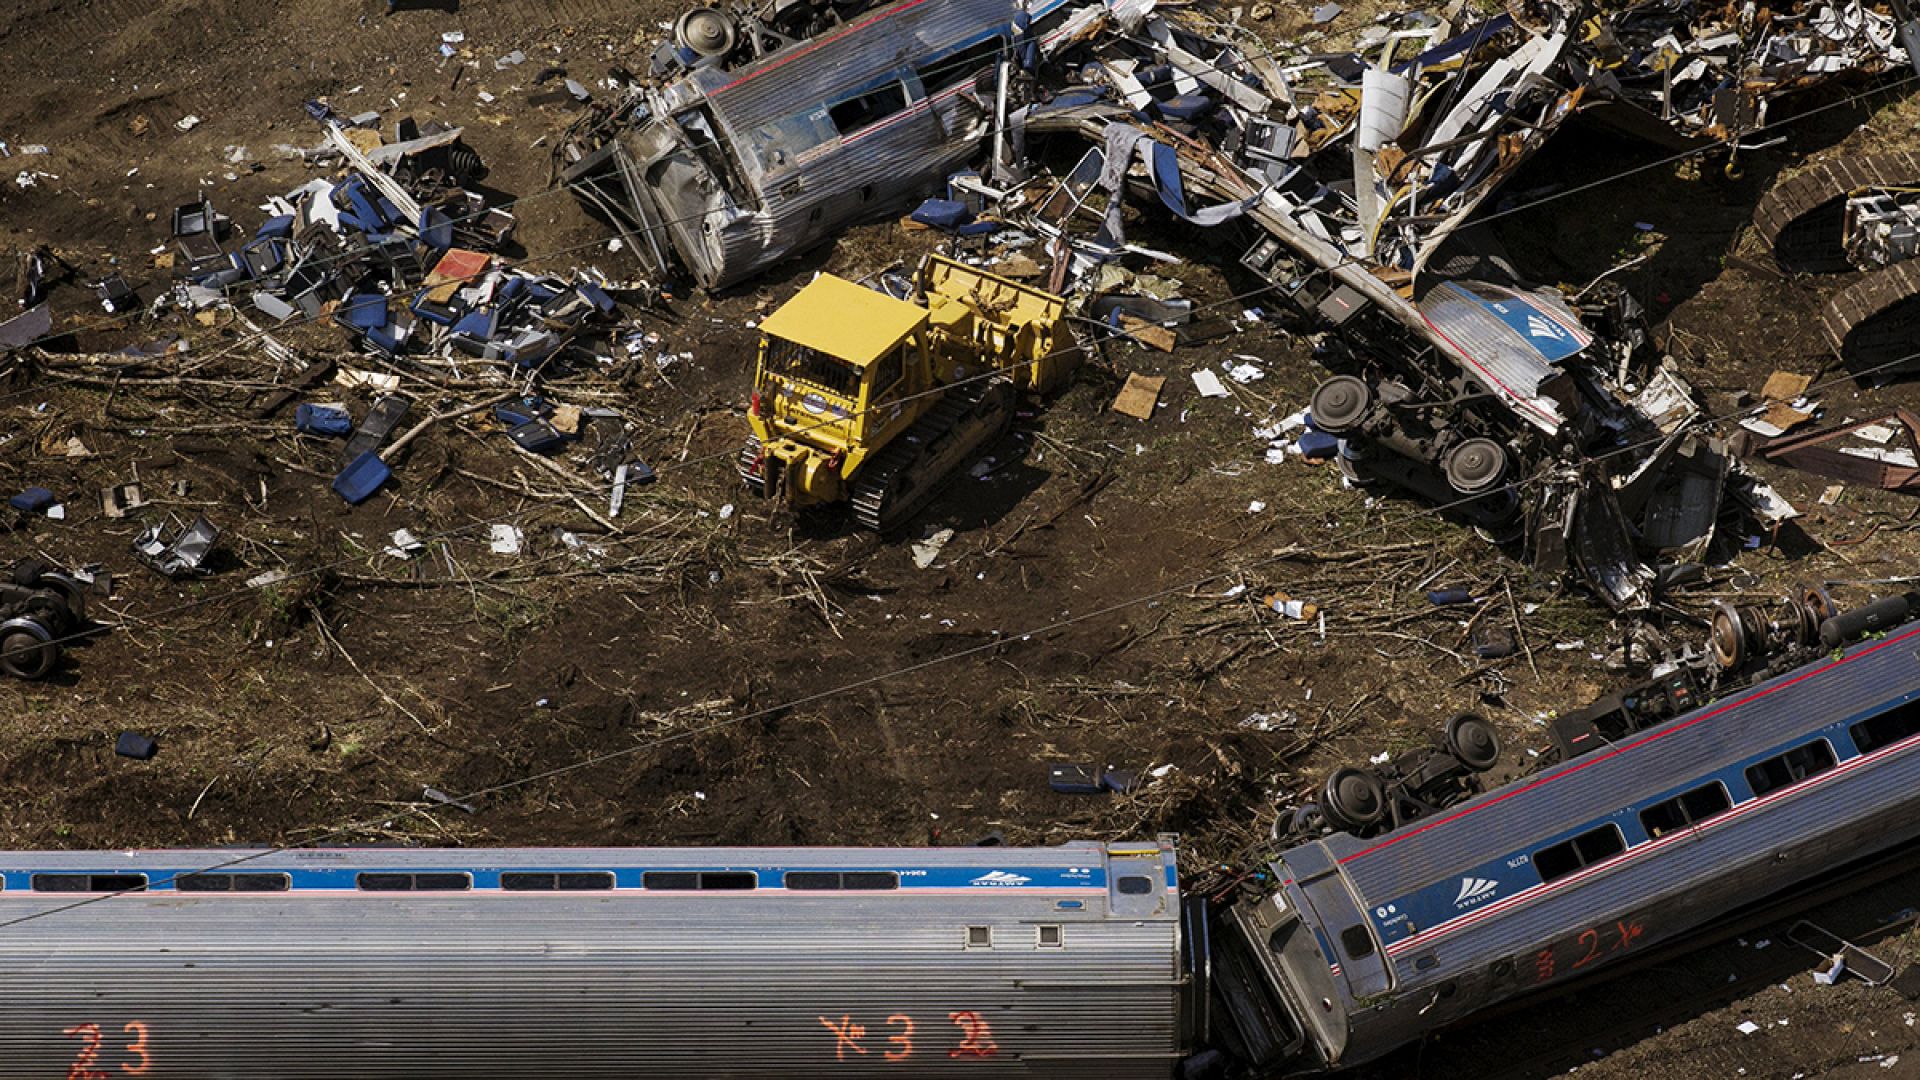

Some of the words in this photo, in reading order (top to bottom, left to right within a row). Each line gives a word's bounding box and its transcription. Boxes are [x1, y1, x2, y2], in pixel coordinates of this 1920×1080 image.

[1456, 889, 1497, 909] AMTRAK
[121, 1020, 150, 1074] 3
[884, 1013, 916, 1061] 3
